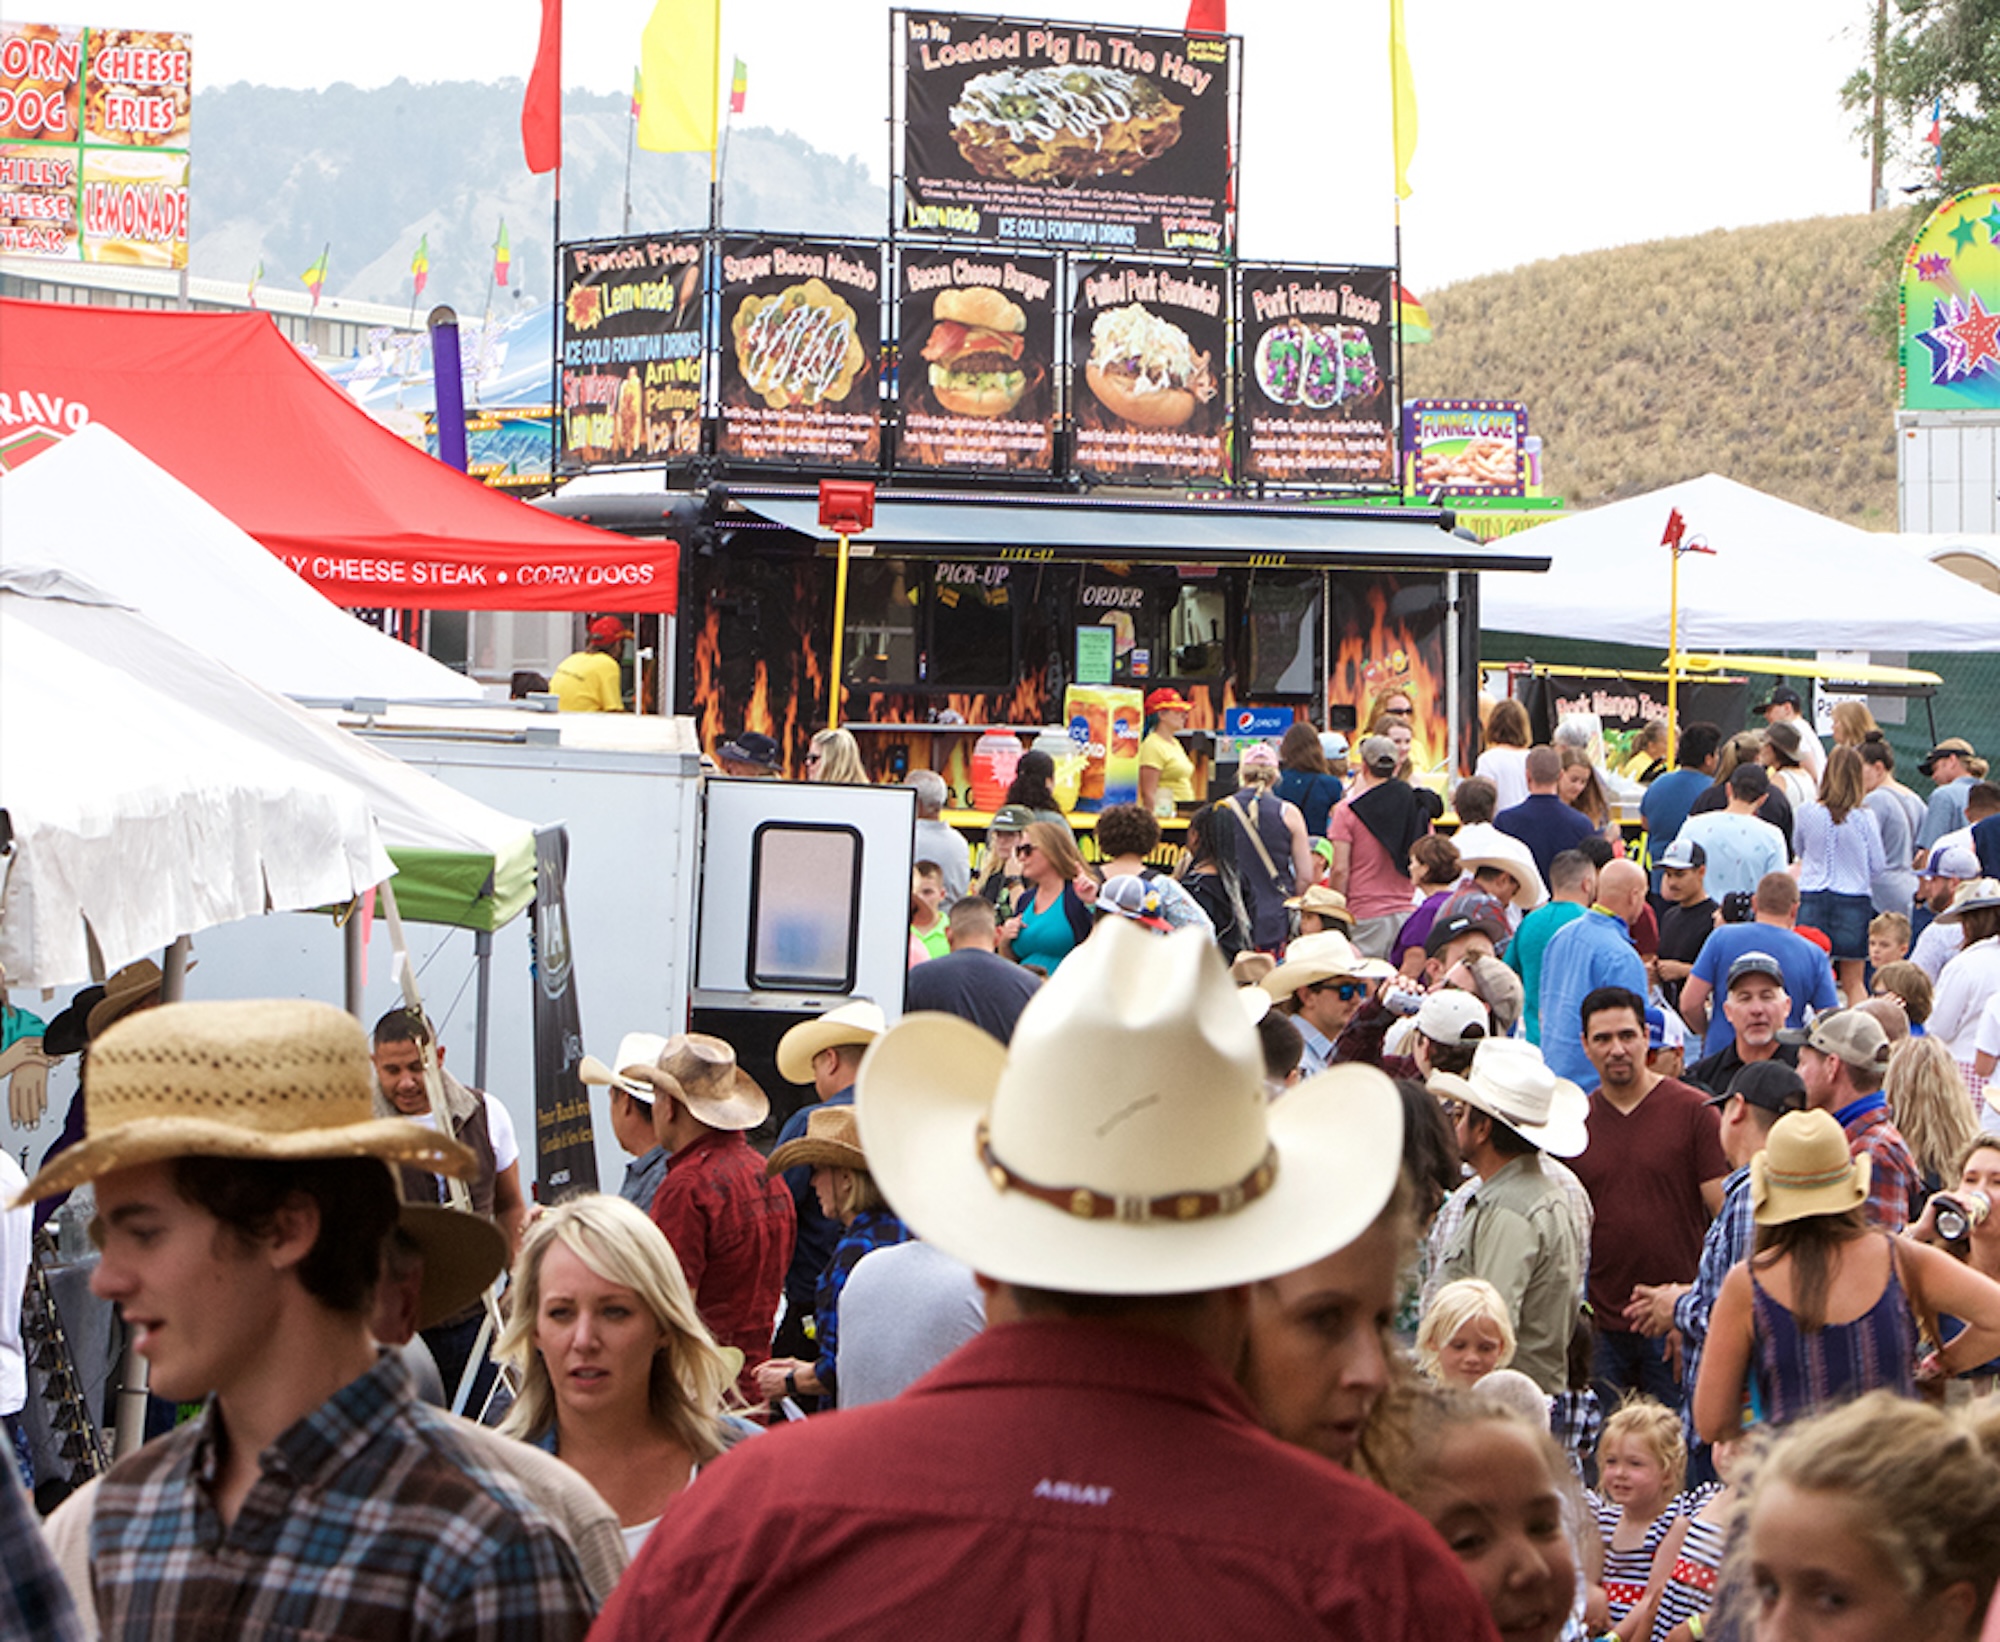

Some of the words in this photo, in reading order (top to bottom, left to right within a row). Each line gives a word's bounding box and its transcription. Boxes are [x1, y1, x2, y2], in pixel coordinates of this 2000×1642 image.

[96, 49, 187, 84] CHEESE
[920, 31, 1020, 71] Loaded
[1027, 30, 1071, 64] Pig
[1076, 33, 1101, 62] In
[1108, 37, 1156, 73] The
[1160, 50, 1212, 96] Hay
[105, 96, 175, 131] FRIES
[85, 183, 187, 240] LEMONADE
[908, 202, 980, 234] Lemonade
[998, 217, 1017, 237] ICE
[1018, 218, 1046, 239] COLD
[1099, 223, 1137, 245] DRINKS
[574, 246, 646, 273] French
[647, 242, 699, 267] Fries
[723, 253, 772, 284] Super
[773, 247, 825, 277] Bacon
[827, 252, 877, 292] Nacho
[602, 274, 675, 318] Lemonade
[906, 262, 953, 292] Bacon
[1003, 262, 1051, 301] Burger
[1084, 270, 1126, 309] Pulled
[1126, 269, 1158, 303] Pork
[1158, 270, 1220, 317] Sandwich
[1252, 284, 1288, 322] Pork
[1288, 281, 1340, 315] Fusion
[1340, 284, 1381, 325] Tacos
[565, 338, 582, 366] ICE
[583, 337, 611, 364] COLD
[663, 330, 701, 359] DRINKS
[645, 358, 701, 387] Arnold
[645, 383, 700, 413] Palmer
[645, 414, 670, 455] Ice
[671, 408, 700, 453] Tea
[1423, 414, 1476, 438] FUNNEL
[1477, 414, 1513, 439] CAKE
[312, 557, 405, 582] CHEESE
[411, 562, 487, 585] STEAK
[516, 564, 585, 586] CORN
[587, 564, 654, 585] DOGS
[935, 563, 1009, 585] PICK-UP
[1083, 587, 1145, 608] ORDER
[1033, 1477, 1114, 1505] ARIAT
